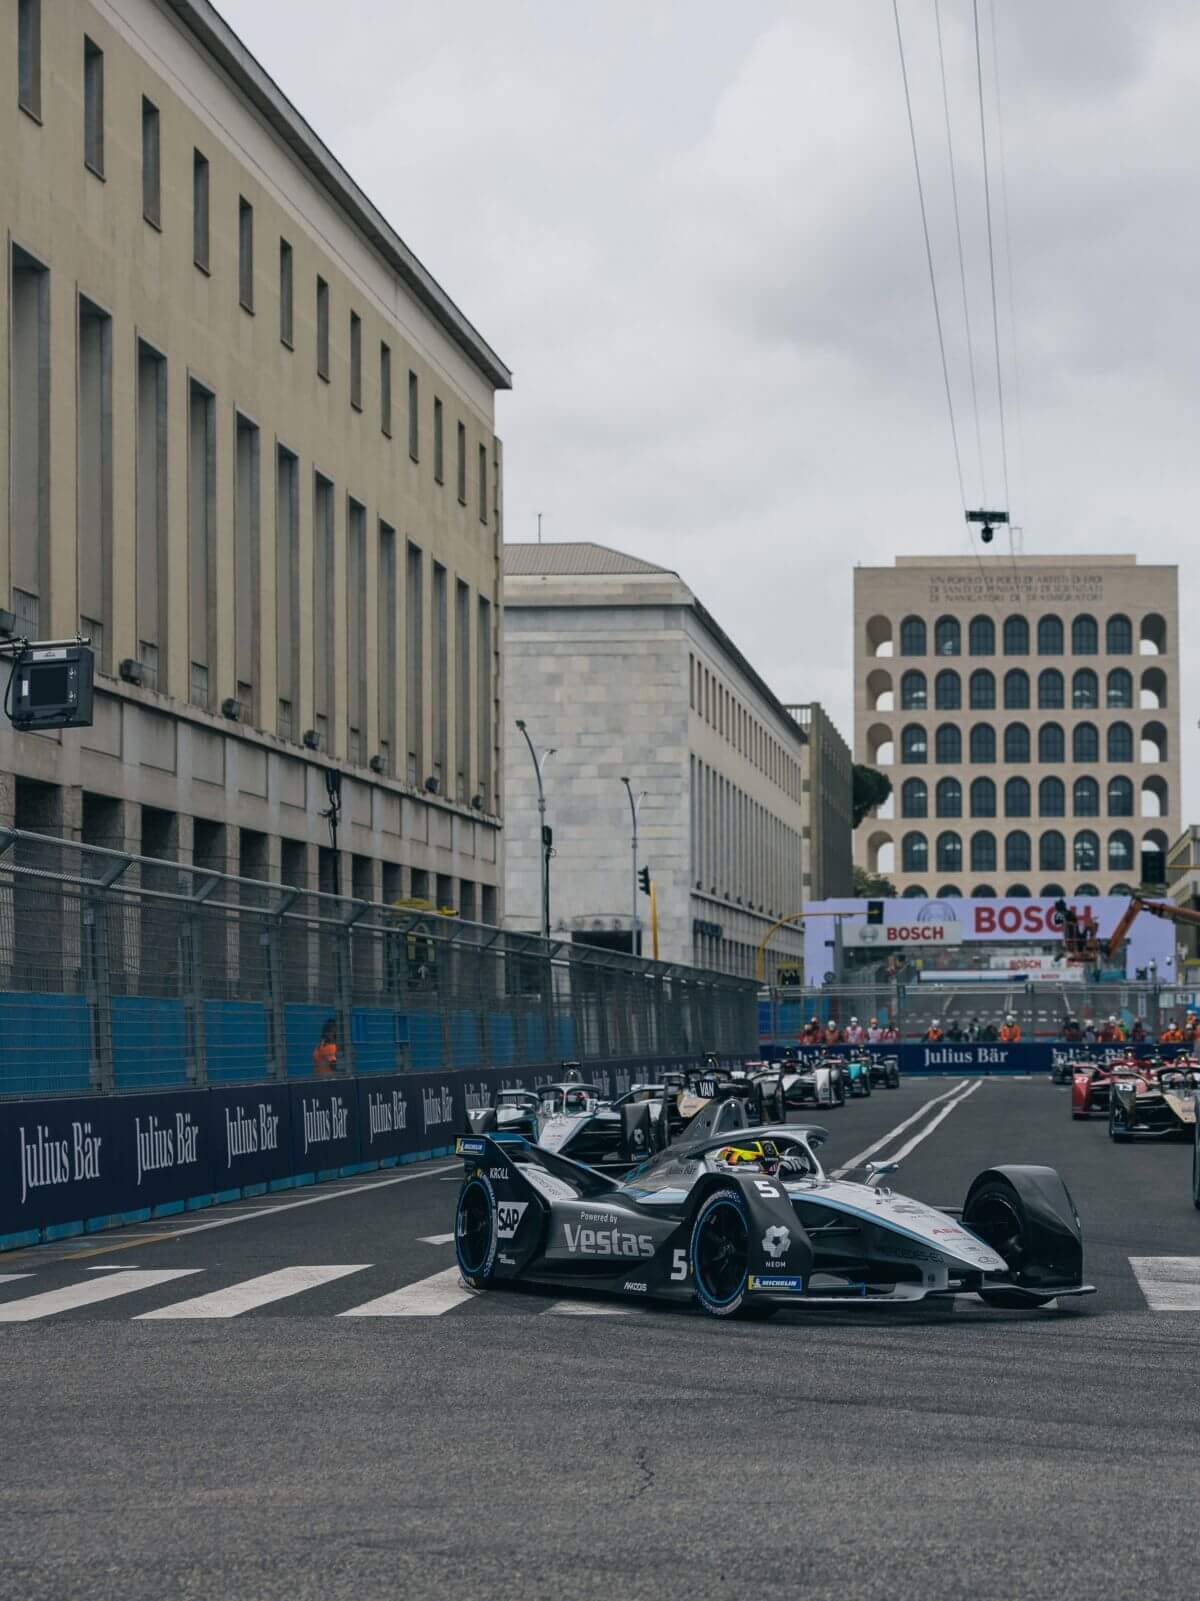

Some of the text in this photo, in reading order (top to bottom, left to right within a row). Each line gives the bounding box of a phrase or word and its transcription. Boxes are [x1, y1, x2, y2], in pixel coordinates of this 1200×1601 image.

[887, 926, 944, 941] BOSCH
[924, 1047, 1008, 1066] Julius Bär
[699, 1081, 714, 1097] VAN
[302, 1096, 348, 1155] Julius Bär
[368, 1091, 407, 1144] Julius Bär
[469, 1111, 488, 1120] 17
[135, 1112, 198, 1185] Julius Bär
[225, 1104, 278, 1168] Julius Bär
[19, 1122, 101, 1204] Julius Bär
[754, 1180, 780, 1198] 5
[498, 1207, 519, 1231] SAP
[580, 1211, 618, 1224] Powered by
[563, 1223, 655, 1257] Vestas
[670, 1249, 688, 1281] 5
